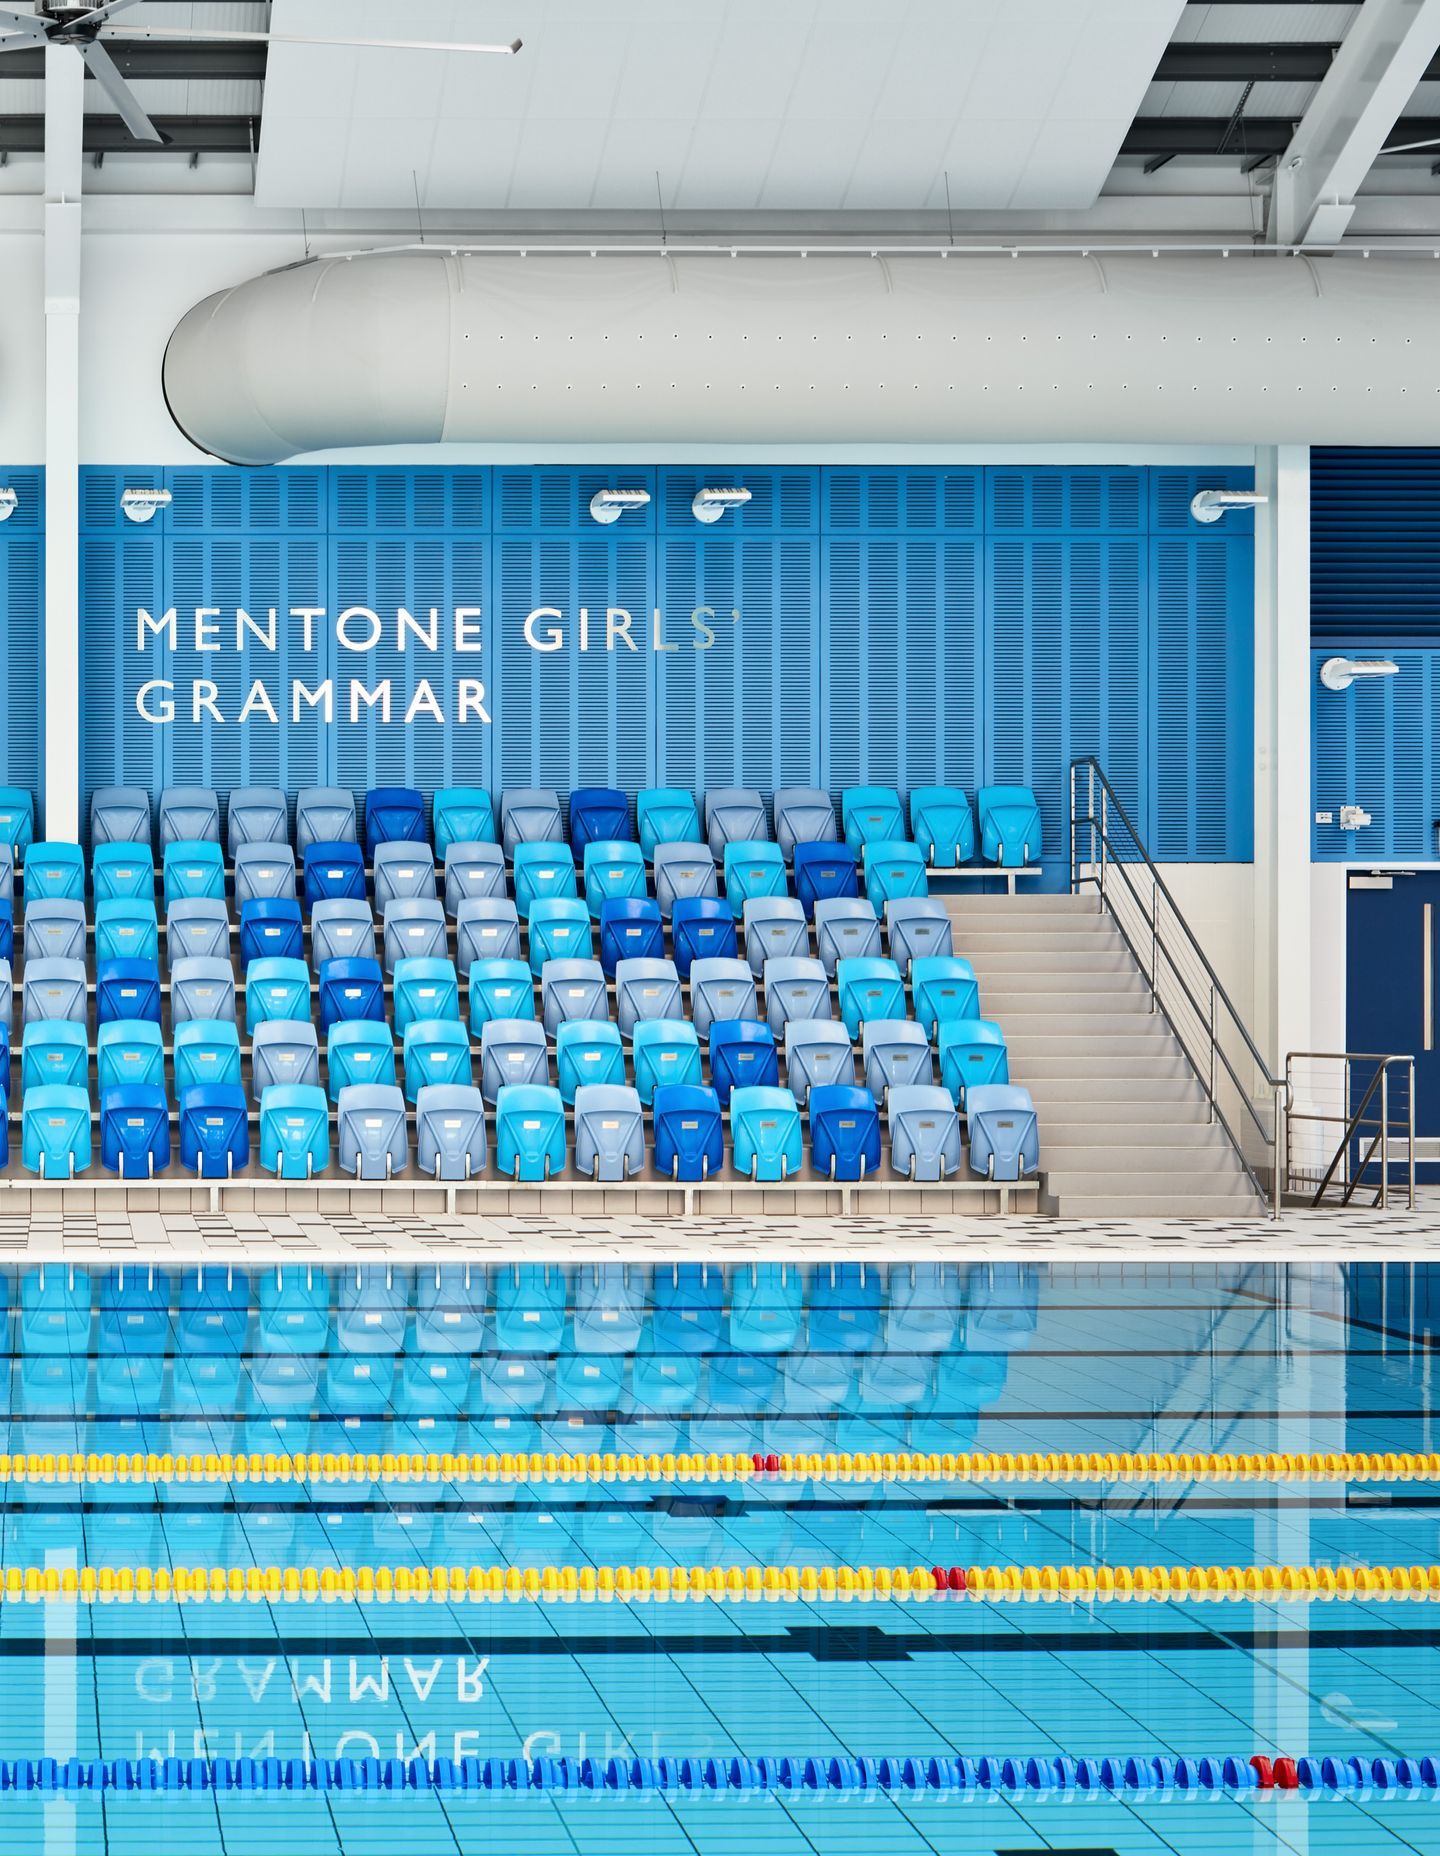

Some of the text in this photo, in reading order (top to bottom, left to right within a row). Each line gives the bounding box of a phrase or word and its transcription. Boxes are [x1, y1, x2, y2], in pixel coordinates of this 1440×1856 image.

[137, 607, 741, 652] MENTONE GIRLS'
[136, 679, 492, 723] GRAMMAR
